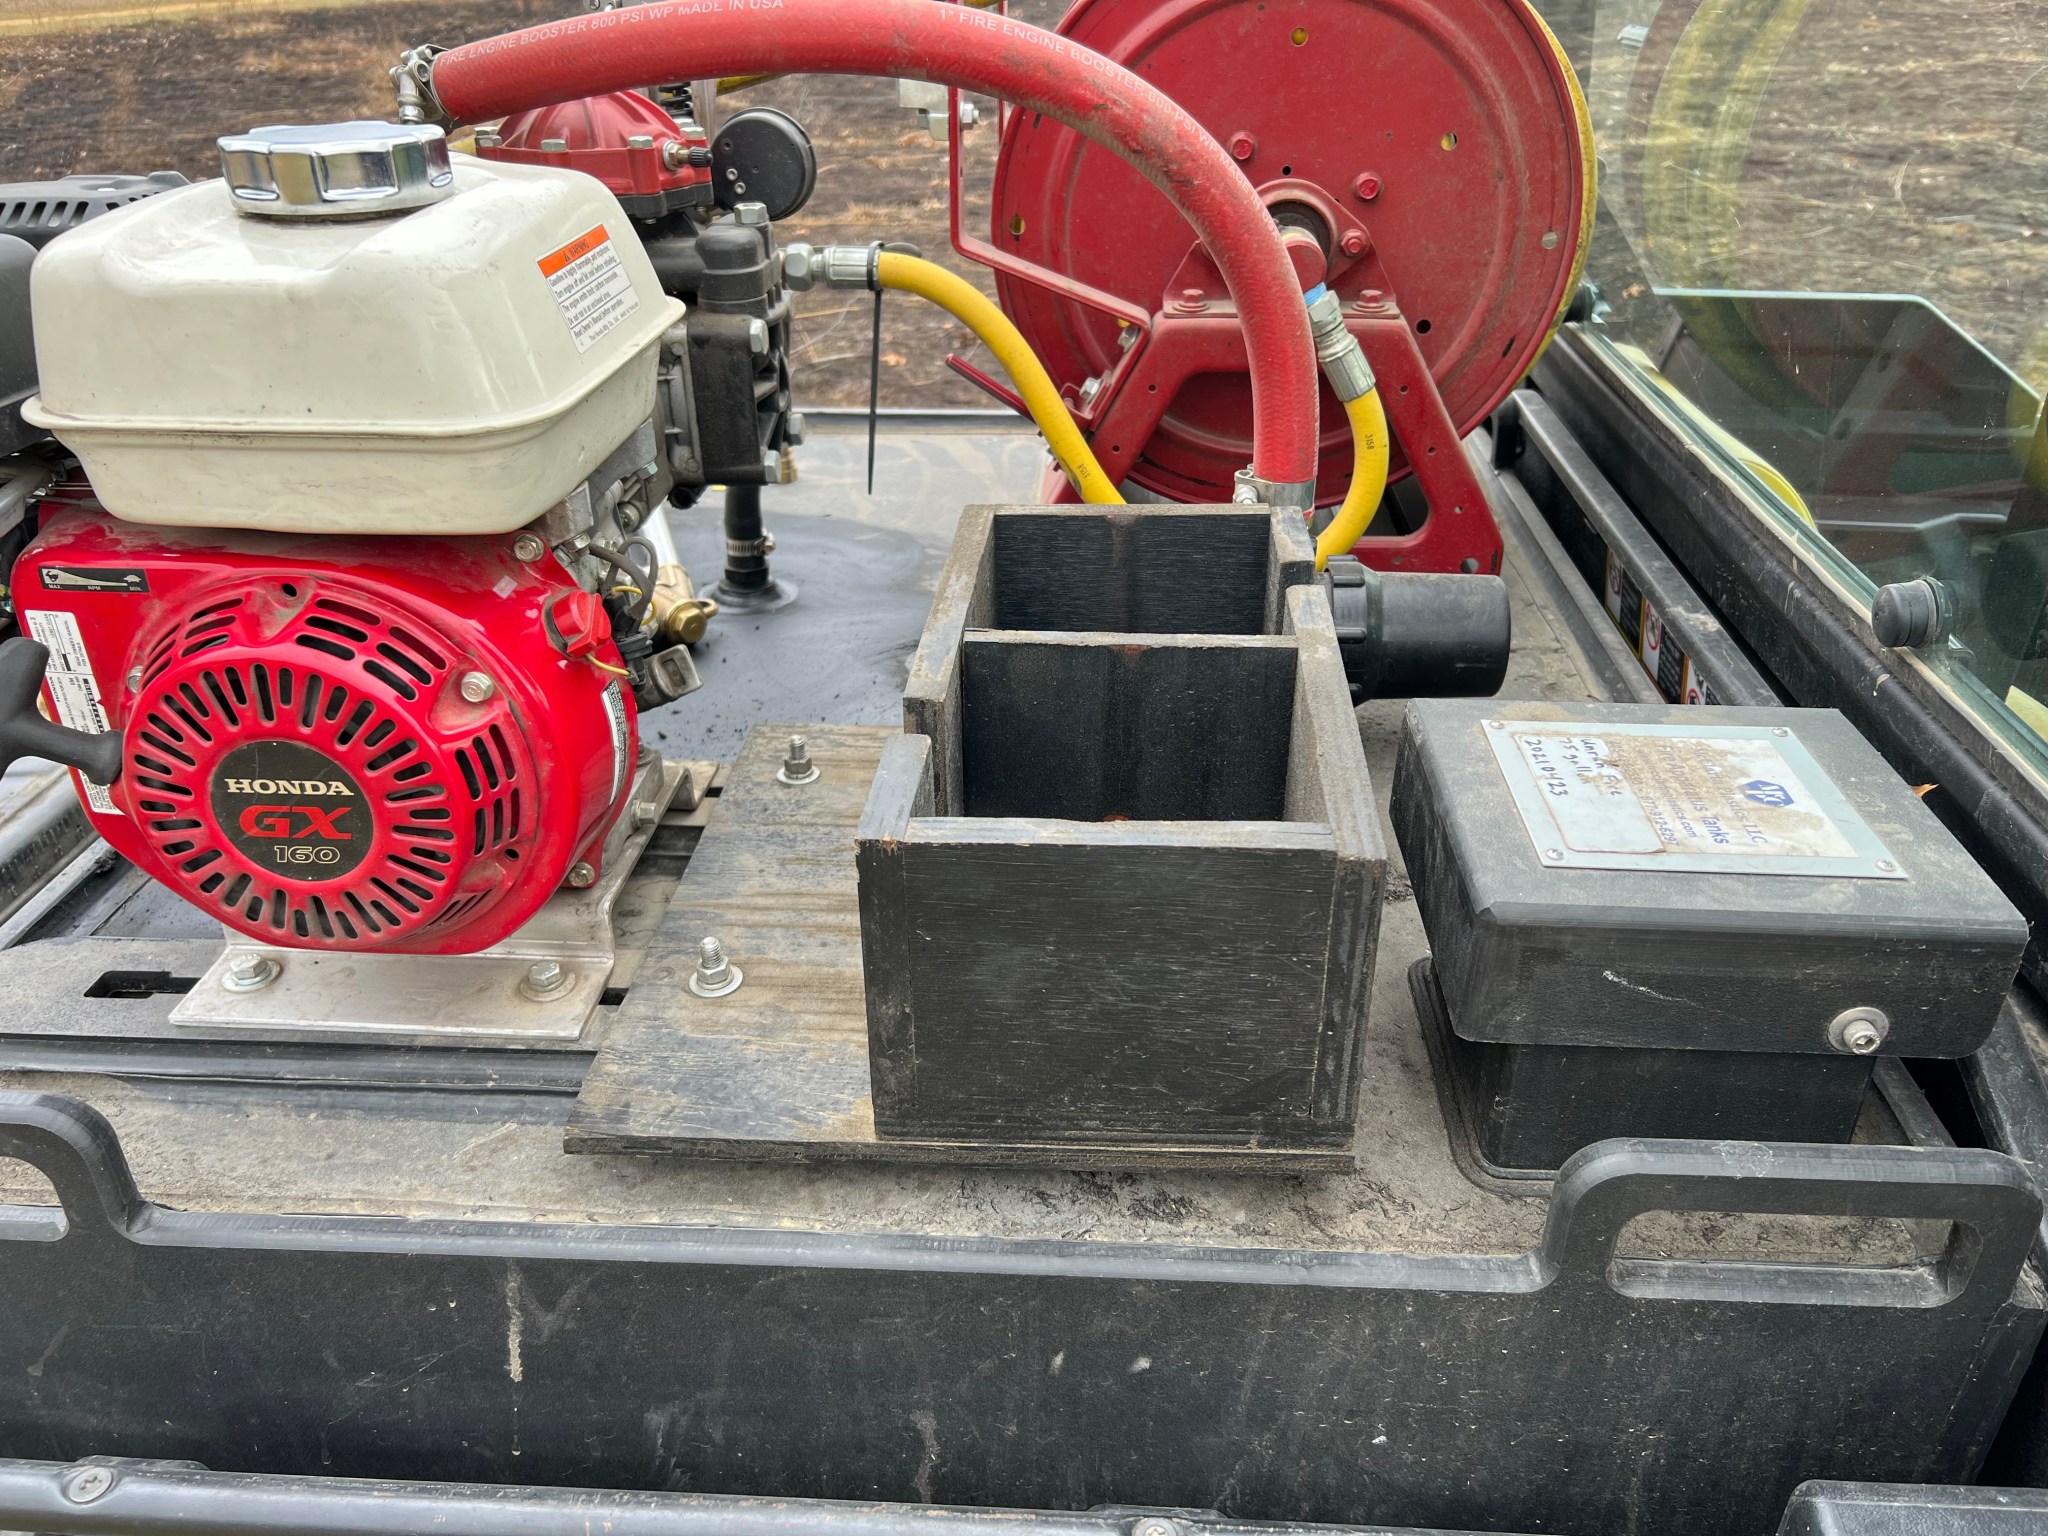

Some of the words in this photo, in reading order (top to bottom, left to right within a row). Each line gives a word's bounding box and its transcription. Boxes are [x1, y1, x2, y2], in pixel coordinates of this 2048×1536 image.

[439, 49, 466, 67] FIRE
[469, 36, 518, 58] ENGINE
[520, 20, 587, 45] BOOSTER
[591, 15, 616, 30] 800
[620, 11, 644, 25] PSI
[649, 6, 674, 20] WP
[678, 1, 723, 16] MADE
[729, 0, 744, 11] IN
[750, 0, 784, 9] USA
[959, 13, 997, 31] FIRE
[1003, 25, 1065, 55] ENGINE
[1070, 49, 1144, 93] BOOSTER
[1147, 92, 1172, 114] 800
[1174, 107, 1195, 134] PSI
[1198, 133, 1218, 152] WP
[1219, 153, 1250, 193] MADE
[568, 239, 589, 257] WARNING
[555, 289, 564, 298] Turn
[49, 677, 60, 702] HONDA
[1560, 738, 1579, 751] 75
[1658, 745, 1676, 761] Fire
[224, 779, 354, 796] HONDA
[1666, 763, 1708, 811] Apparatus
[239, 805, 352, 840] GX
[1640, 796, 1679, 845] 877-912-6297
[1702, 815, 1730, 844] Tanks
[1743, 824, 1768, 843] LLC
[274, 846, 340, 864] 160
